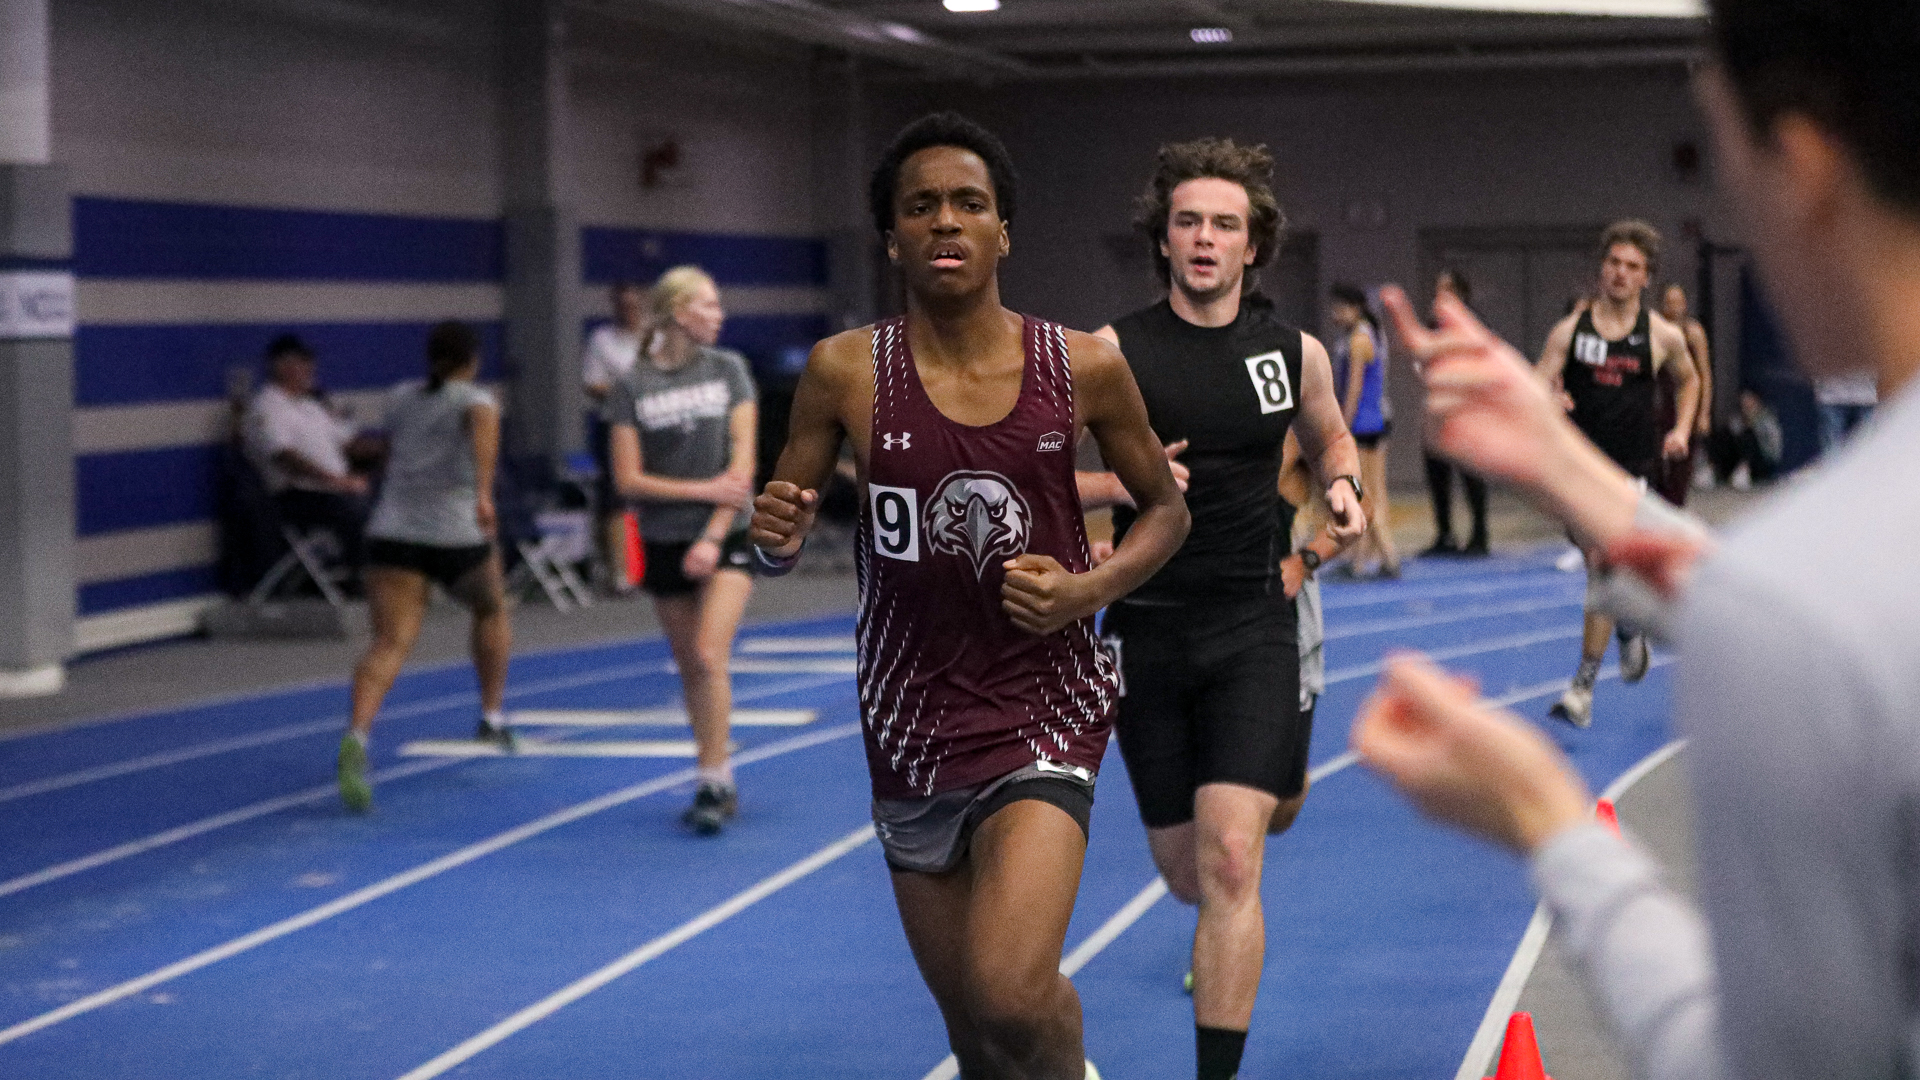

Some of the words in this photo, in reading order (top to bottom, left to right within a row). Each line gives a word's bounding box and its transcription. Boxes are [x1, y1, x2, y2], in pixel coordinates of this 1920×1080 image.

[1256, 359, 1287, 407] 8
[1039, 441, 1062, 450] MAC
[875, 491, 911, 555] 9
